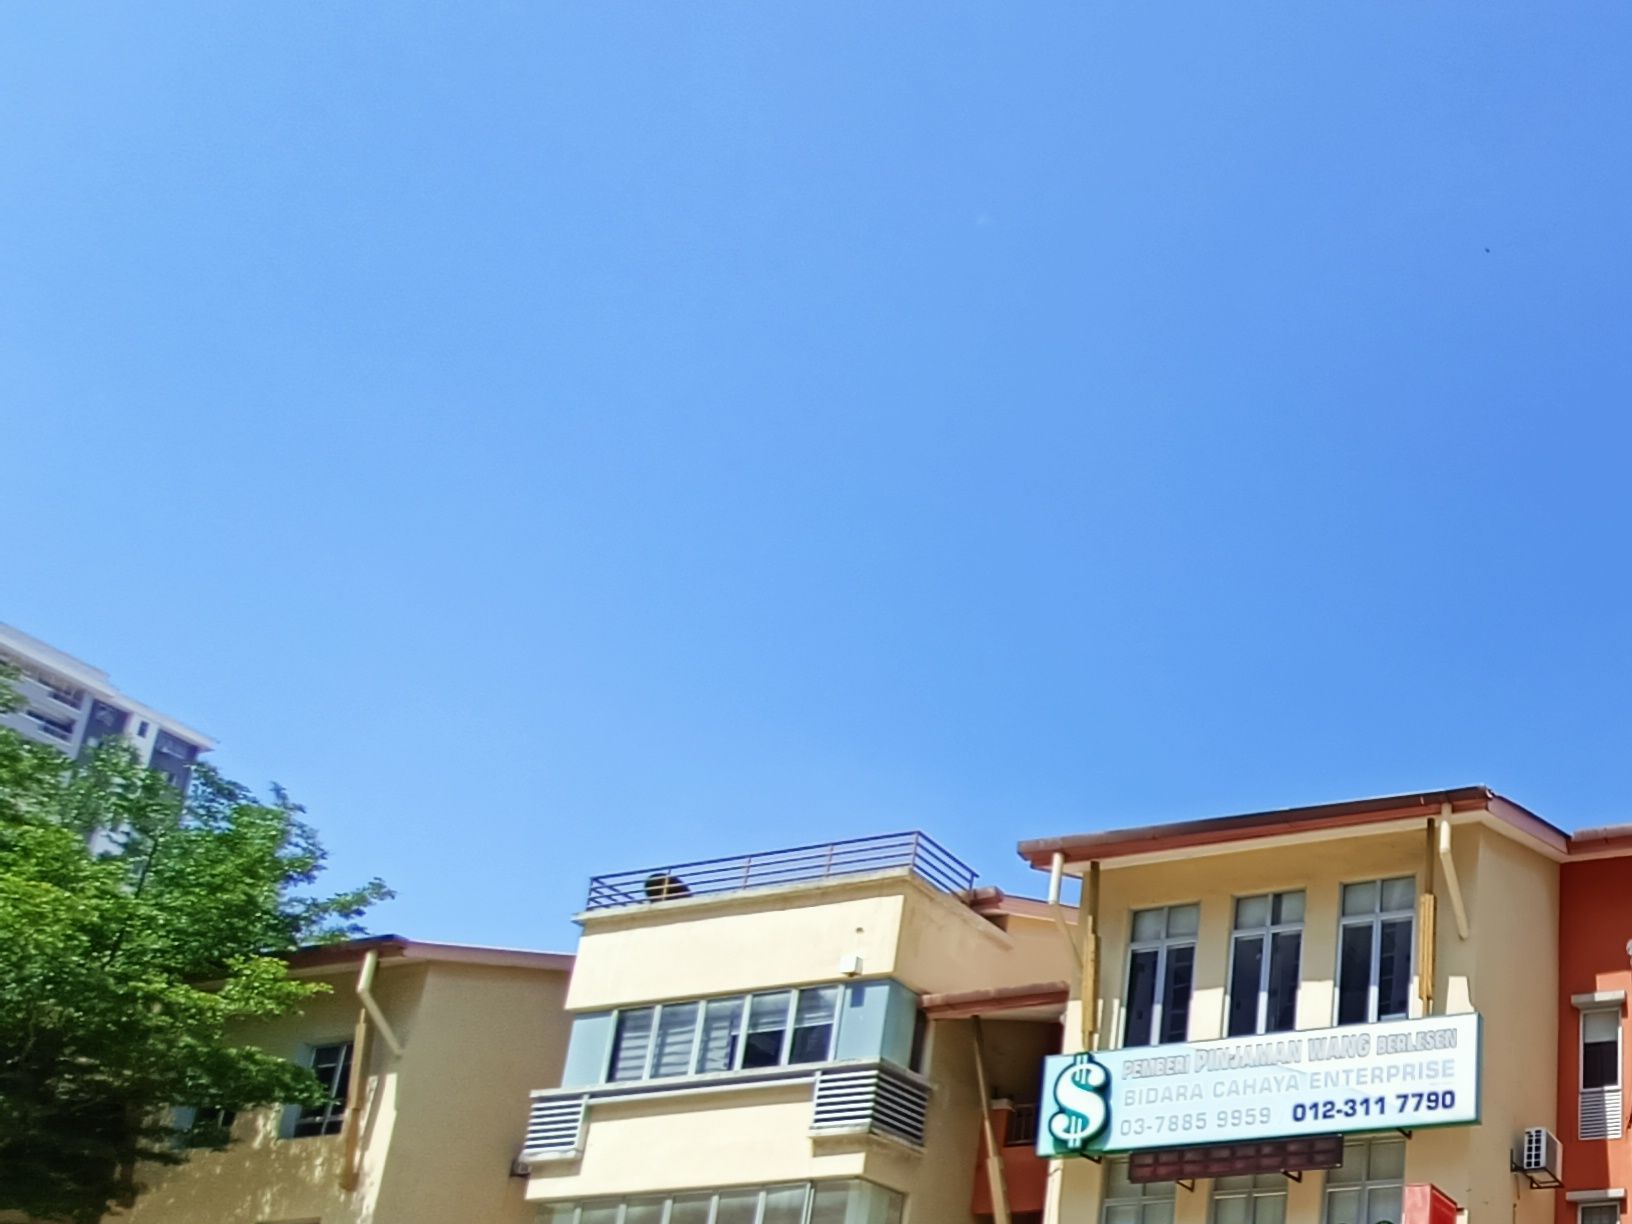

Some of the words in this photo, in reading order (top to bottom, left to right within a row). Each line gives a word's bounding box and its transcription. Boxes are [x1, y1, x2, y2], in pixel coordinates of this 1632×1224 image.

[1121, 1054, 1191, 1080] PEMBERI
[1194, 1039, 1302, 1073] PINJAMAN
[1307, 1033, 1371, 1062] WANG
[1376, 1028, 1458, 1056] BERLESEN
[1124, 1084, 1203, 1107] BIDARA
[1212, 1074, 1300, 1098] CAHAYA
[1309, 1059, 1455, 1090] ENTERPRISE
[1120, 1111, 1207, 1136] 03-7885
[1217, 1106, 1271, 1129] 9959
[1292, 1096, 1386, 1122] 012-311
[1395, 1090, 1456, 1113] 7790
